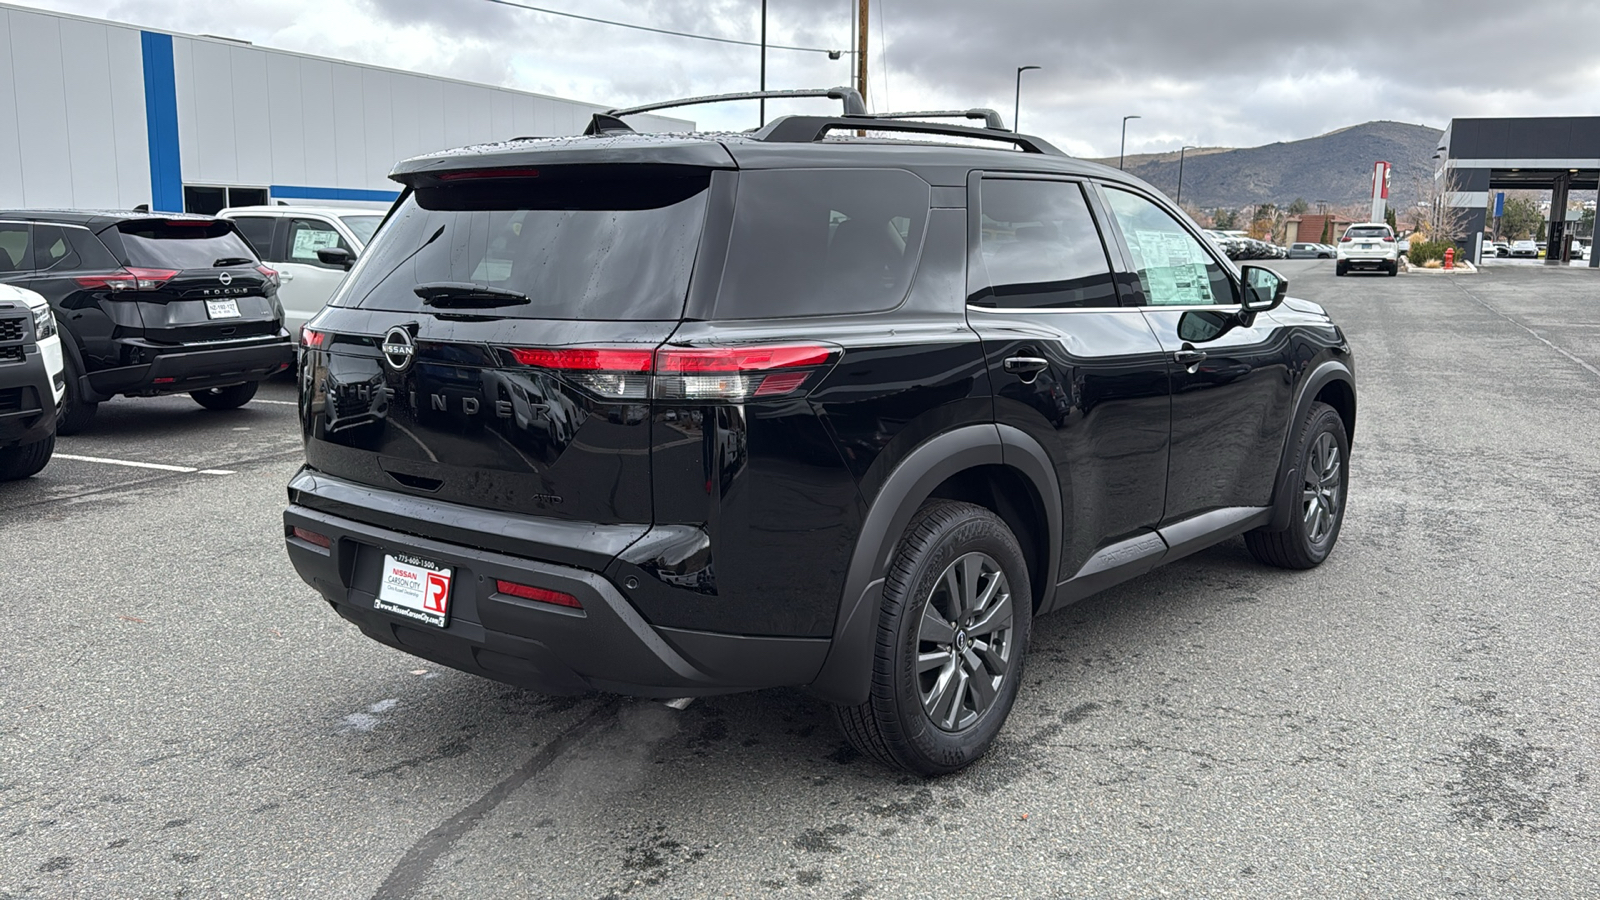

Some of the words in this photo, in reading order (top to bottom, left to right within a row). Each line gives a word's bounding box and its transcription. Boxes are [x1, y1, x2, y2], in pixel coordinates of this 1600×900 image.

[398, 554, 435, 569] 775-600-1500
[392, 568, 418, 580] NISSAN
[388, 575, 409, 587] CARSON
[409, 580, 421, 590] CITY
[429, 576, 447, 612] R
[380, 602, 439, 625] www.NissanCarsonCity.com
